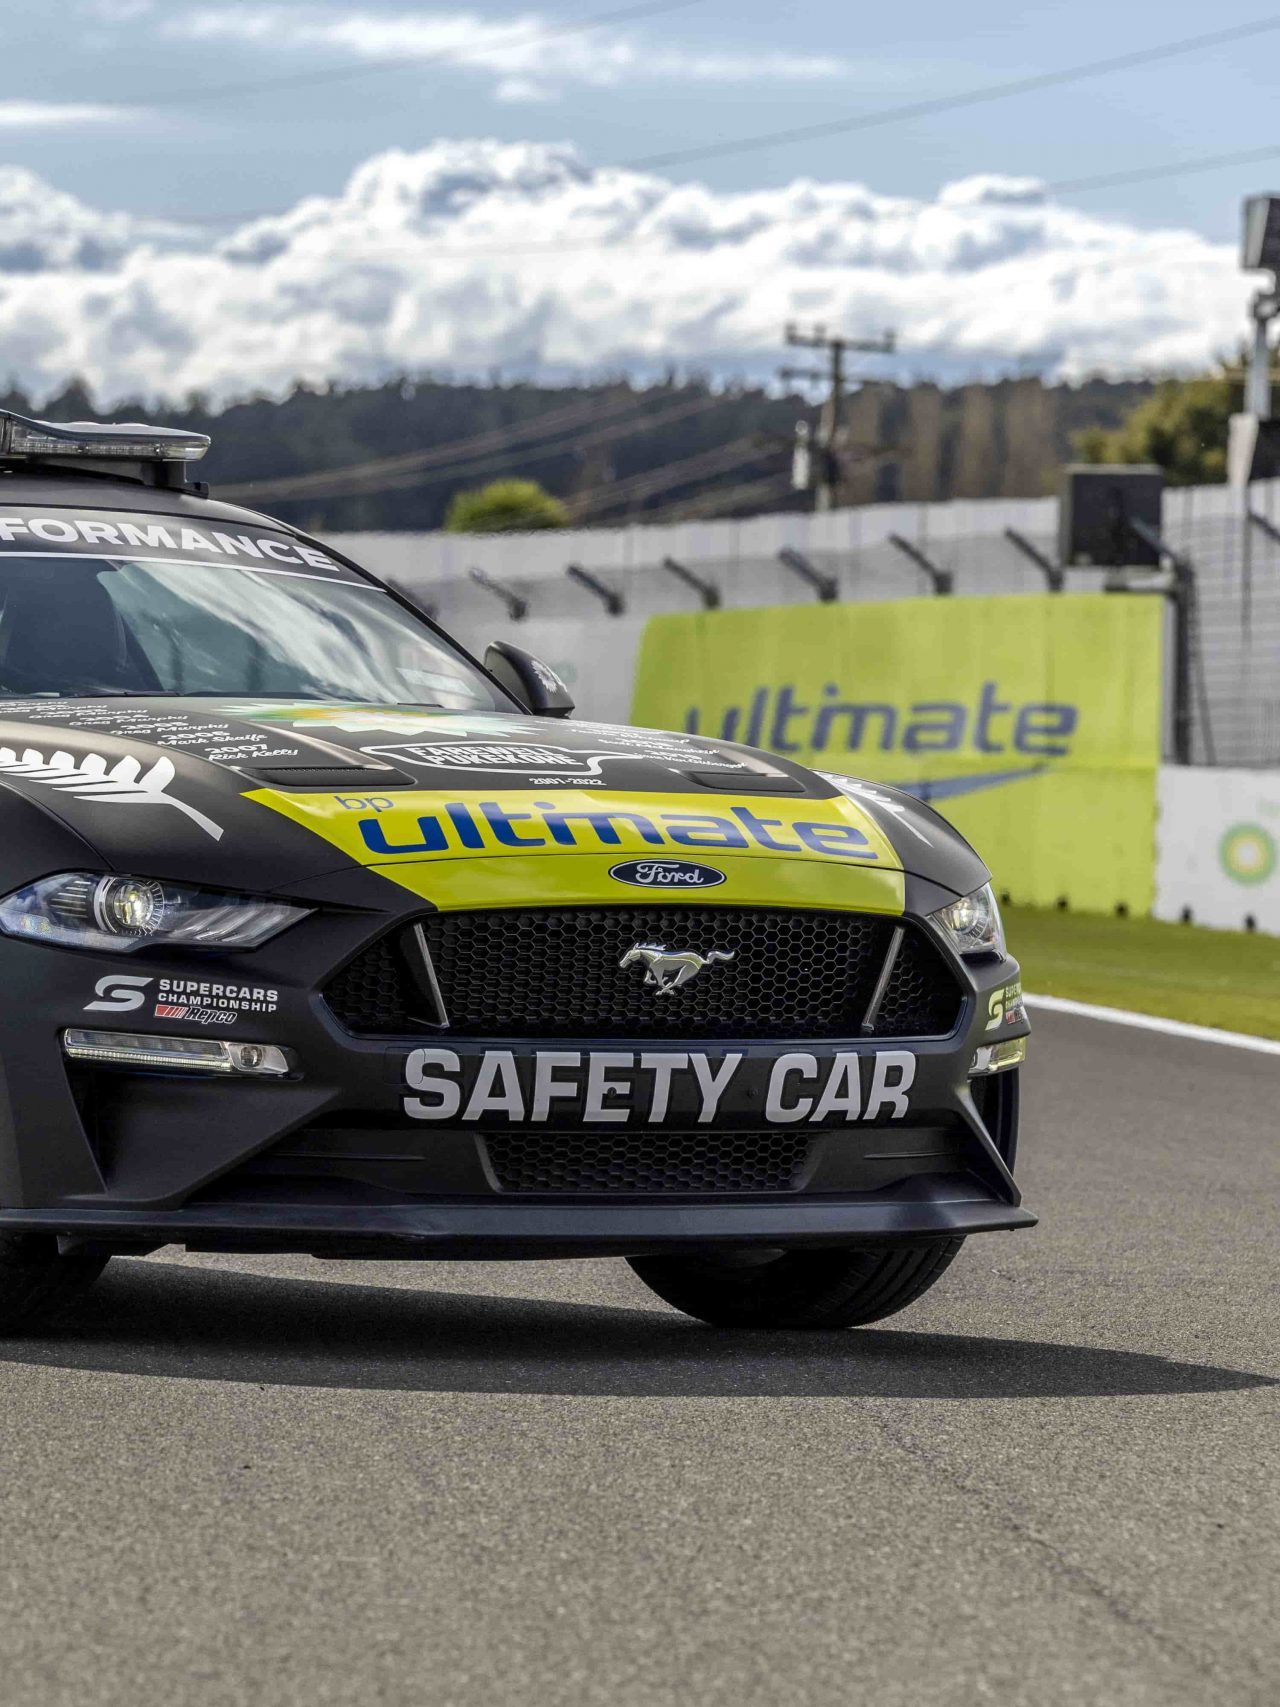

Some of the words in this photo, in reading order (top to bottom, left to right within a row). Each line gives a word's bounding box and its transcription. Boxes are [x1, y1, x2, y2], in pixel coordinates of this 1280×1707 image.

[686, 682, 1078, 757] ultimate
[204, 743, 268, 753] 2007
[209, 752, 249, 761] Rick
[252, 748, 299, 757] Kelly
[404, 746, 564, 756] FAREWELL
[422, 754, 583, 766] PUKEKOHE
[334, 796, 394, 812] bp
[358, 801, 878, 859] ultimate
[636, 861, 705, 886] Ford
[159, 979, 279, 1002] SUPERCARS
[158, 992, 277, 1013] CHAMPIONSHIP
[185, 1006, 237, 1024] Repco
[402, 1048, 743, 1124] SAFETY
[765, 1050, 916, 1124] CAR
